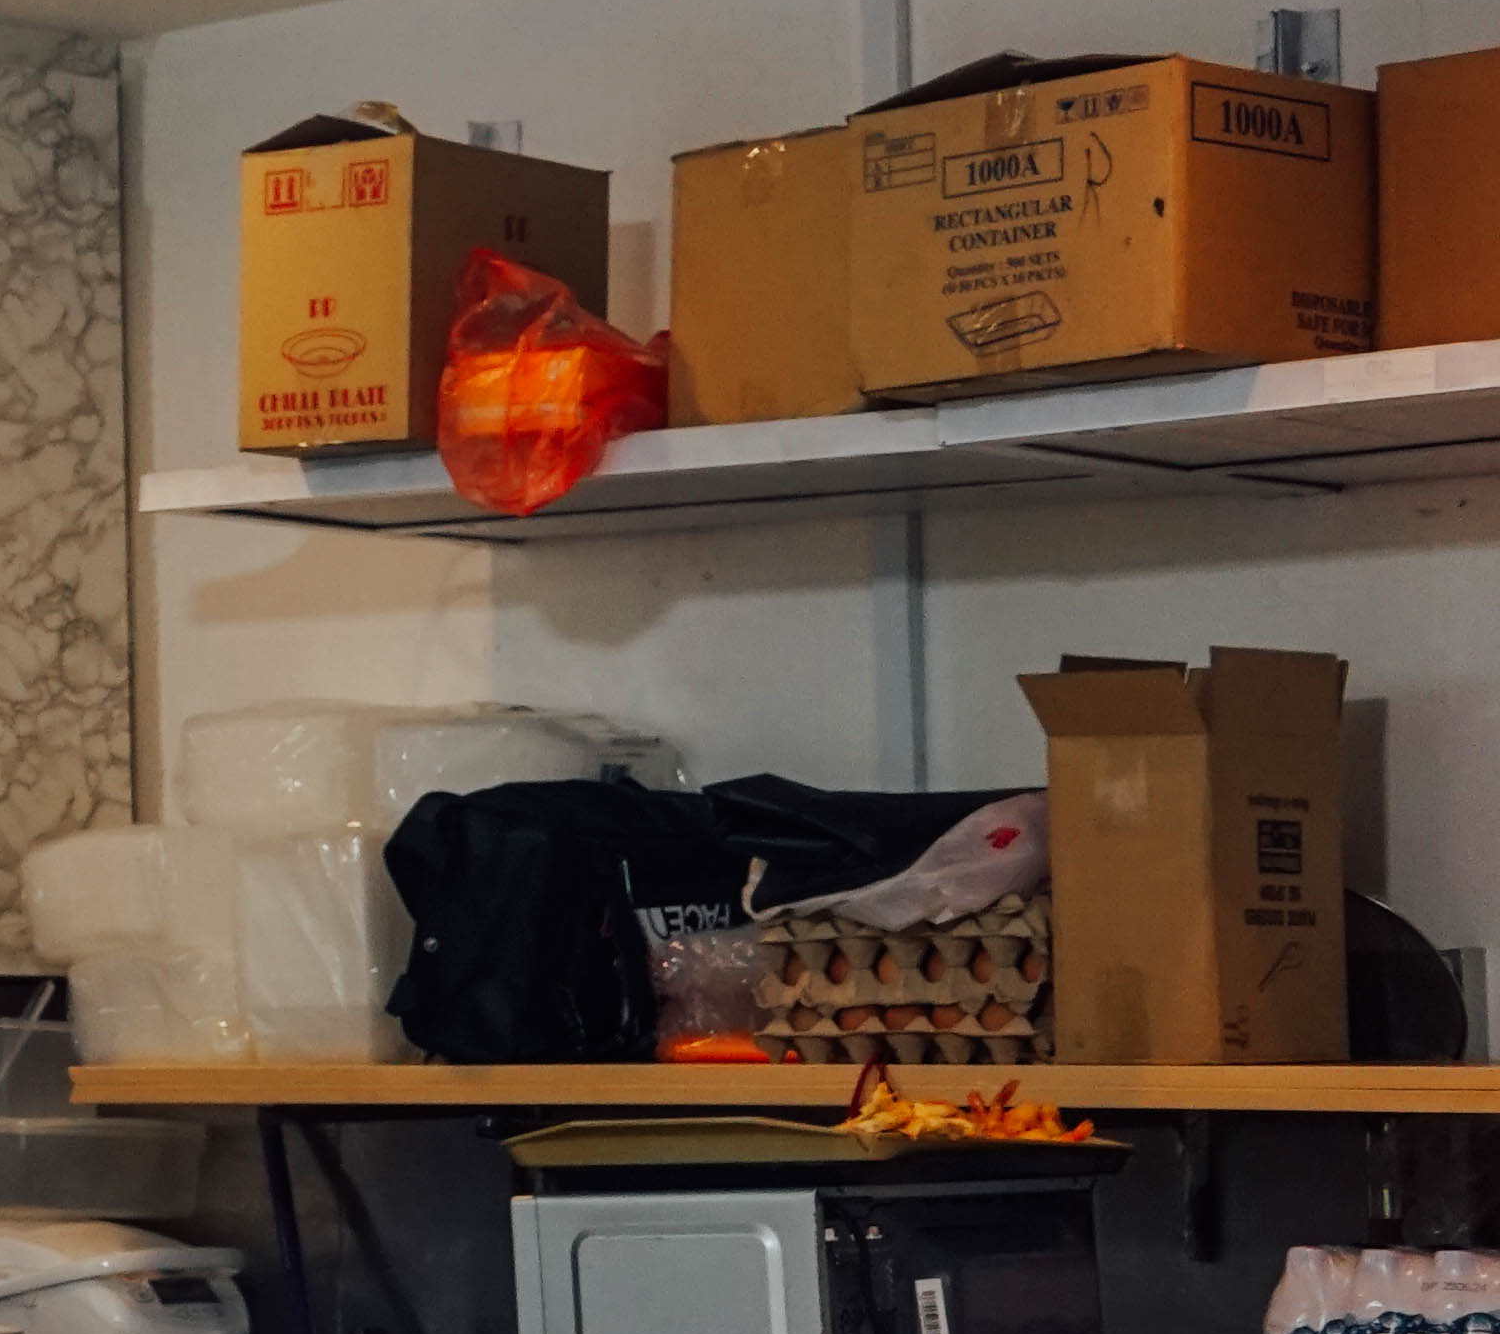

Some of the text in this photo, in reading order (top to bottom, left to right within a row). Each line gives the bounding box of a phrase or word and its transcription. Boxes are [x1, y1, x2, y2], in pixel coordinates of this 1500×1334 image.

[1219, 99, 1304, 145] 1000A
[964, 153, 1041, 186] 1000A
[933, 194, 1072, 232] RECTANGULAR
[948, 221, 1057, 253] CONTAINER
